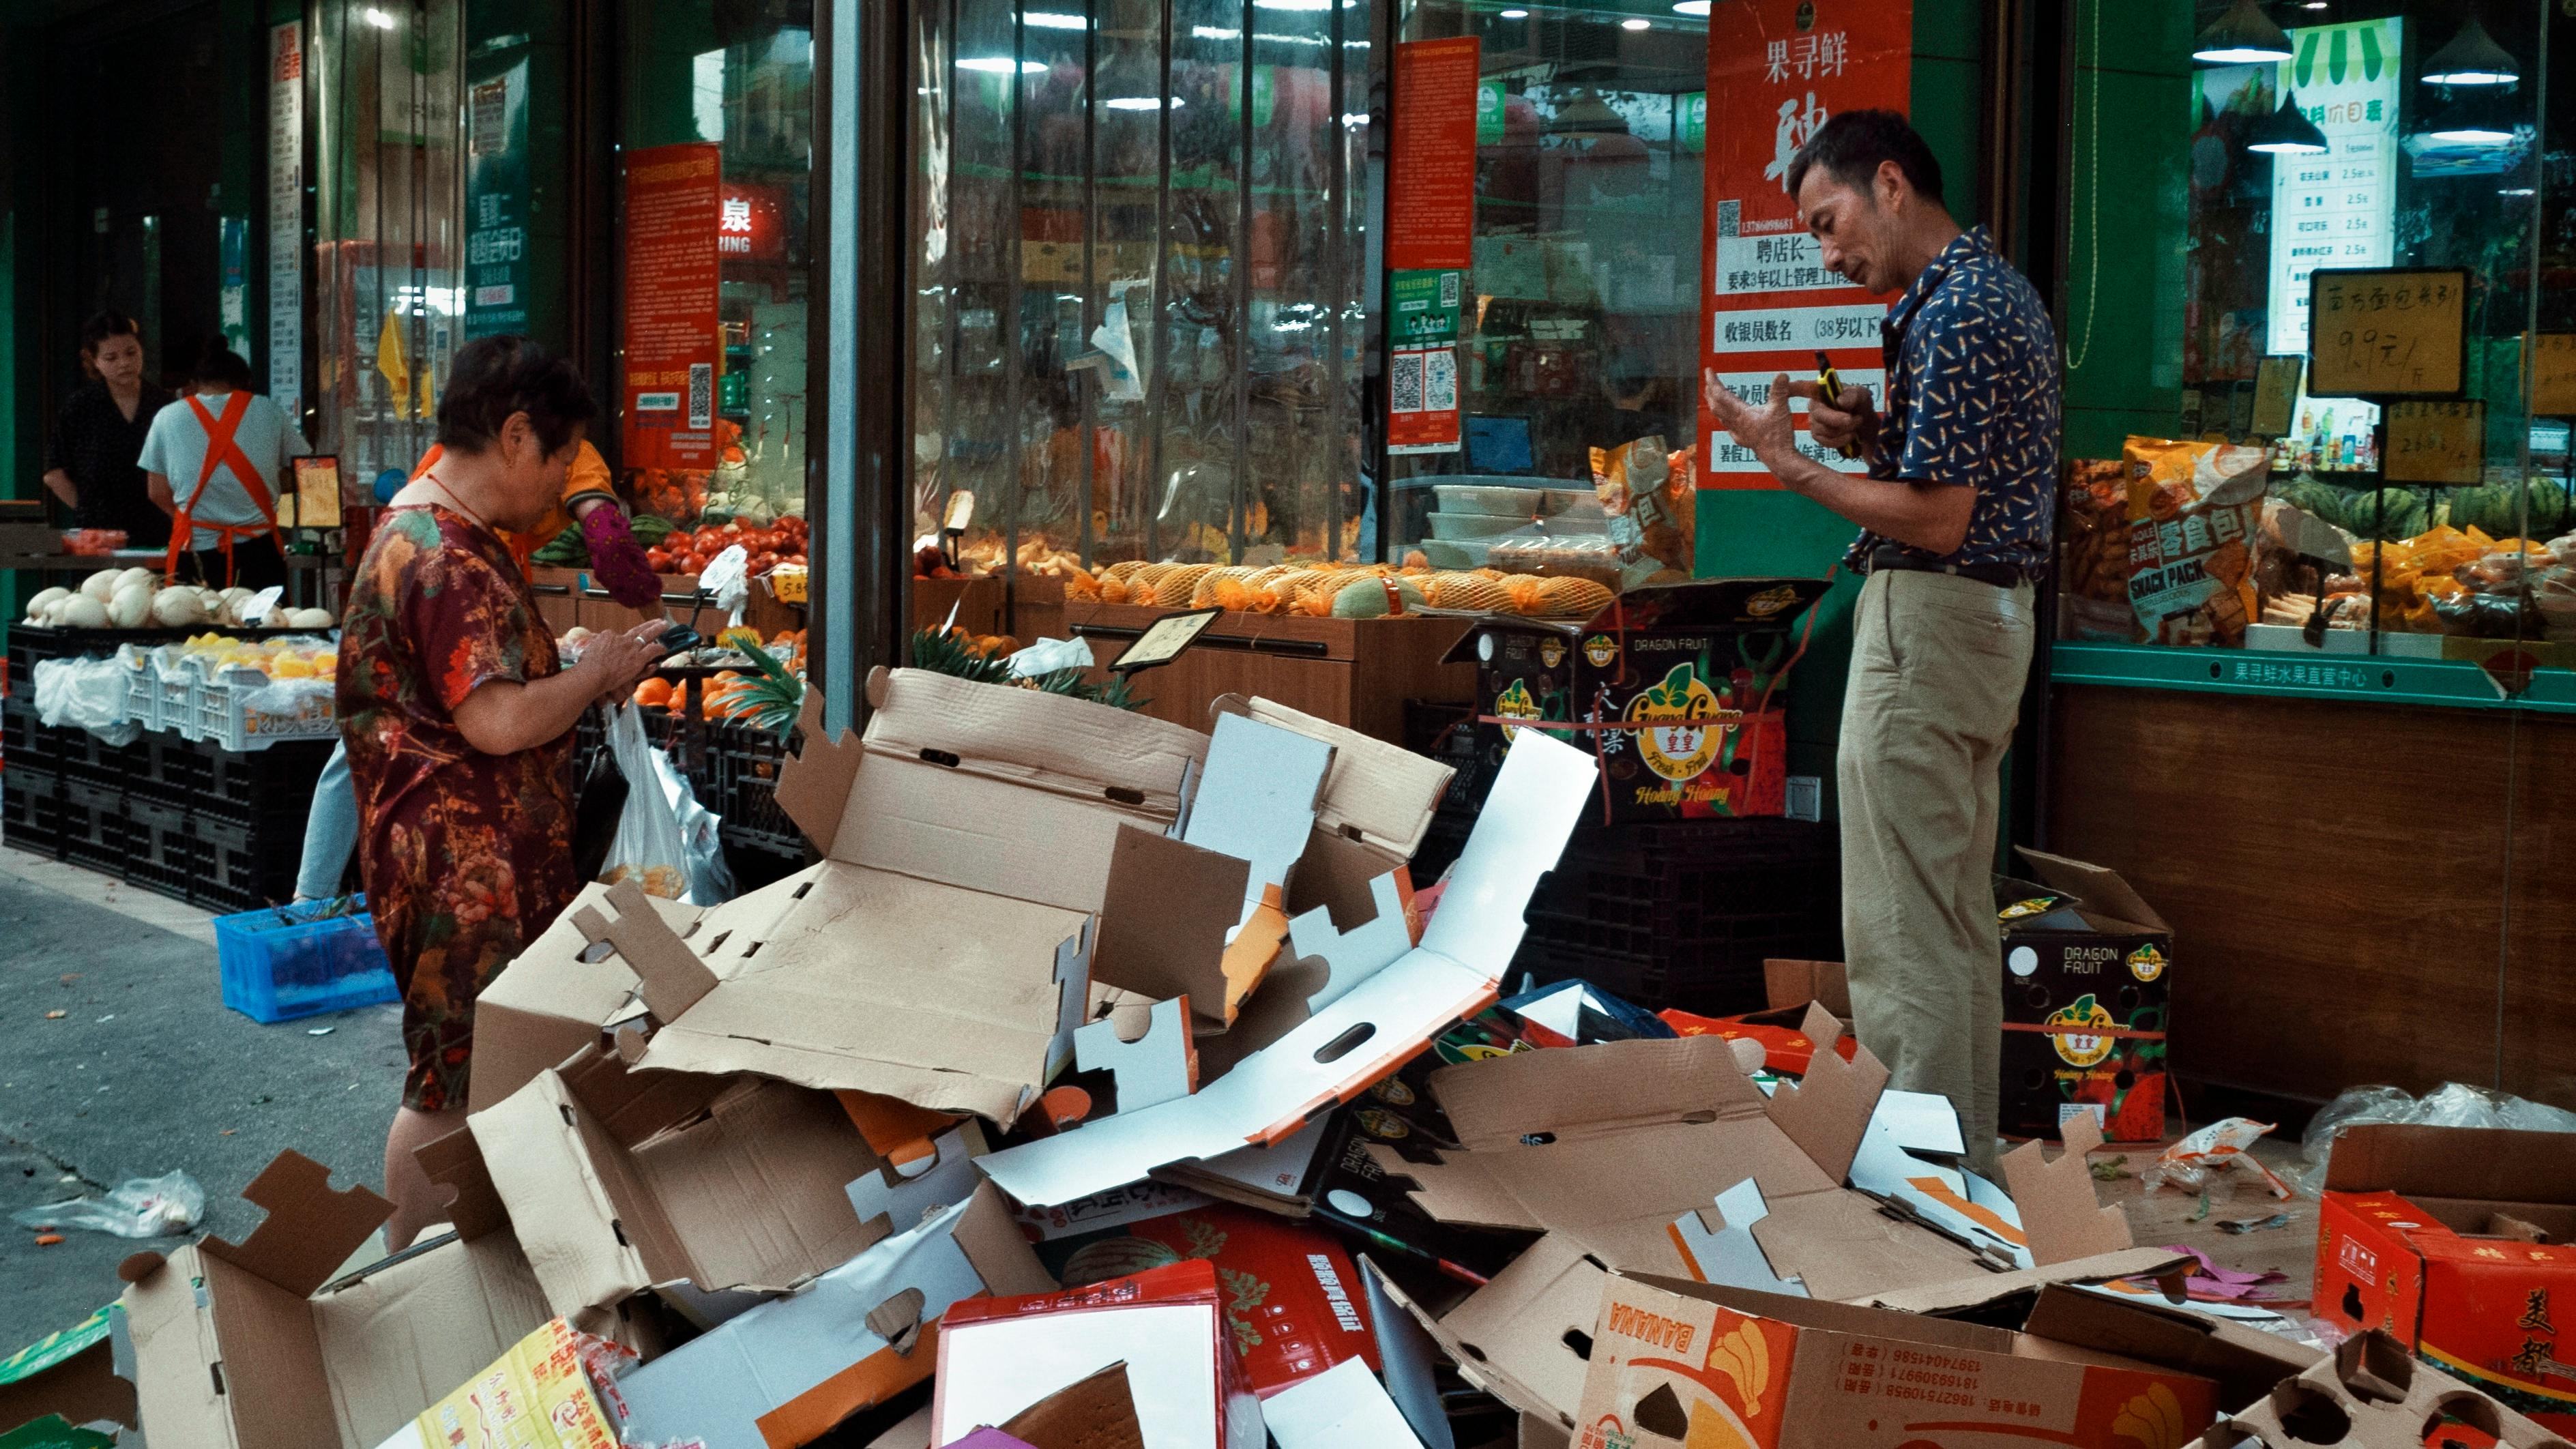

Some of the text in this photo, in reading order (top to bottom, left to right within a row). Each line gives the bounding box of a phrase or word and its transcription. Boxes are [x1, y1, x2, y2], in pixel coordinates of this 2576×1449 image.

[1764, 31, 1848, 83] 果寻鲜
[722, 197, 752, 232] 泉
[1725, 319, 1792, 342] 收银员数名
[2130, 559, 2208, 600] SNACK PACK
[1635, 638, 1708, 652] DRAGON FRUIT
[2235, 662, 2367, 688] 果寻鲜水果直营中心
[1666, 733, 1696, 754] 皇皇
[2064, 947, 2118, 961] DRAGON
[2064, 961, 2103, 974] FRUIT
[1609, 1302, 1695, 1353] BANANA
